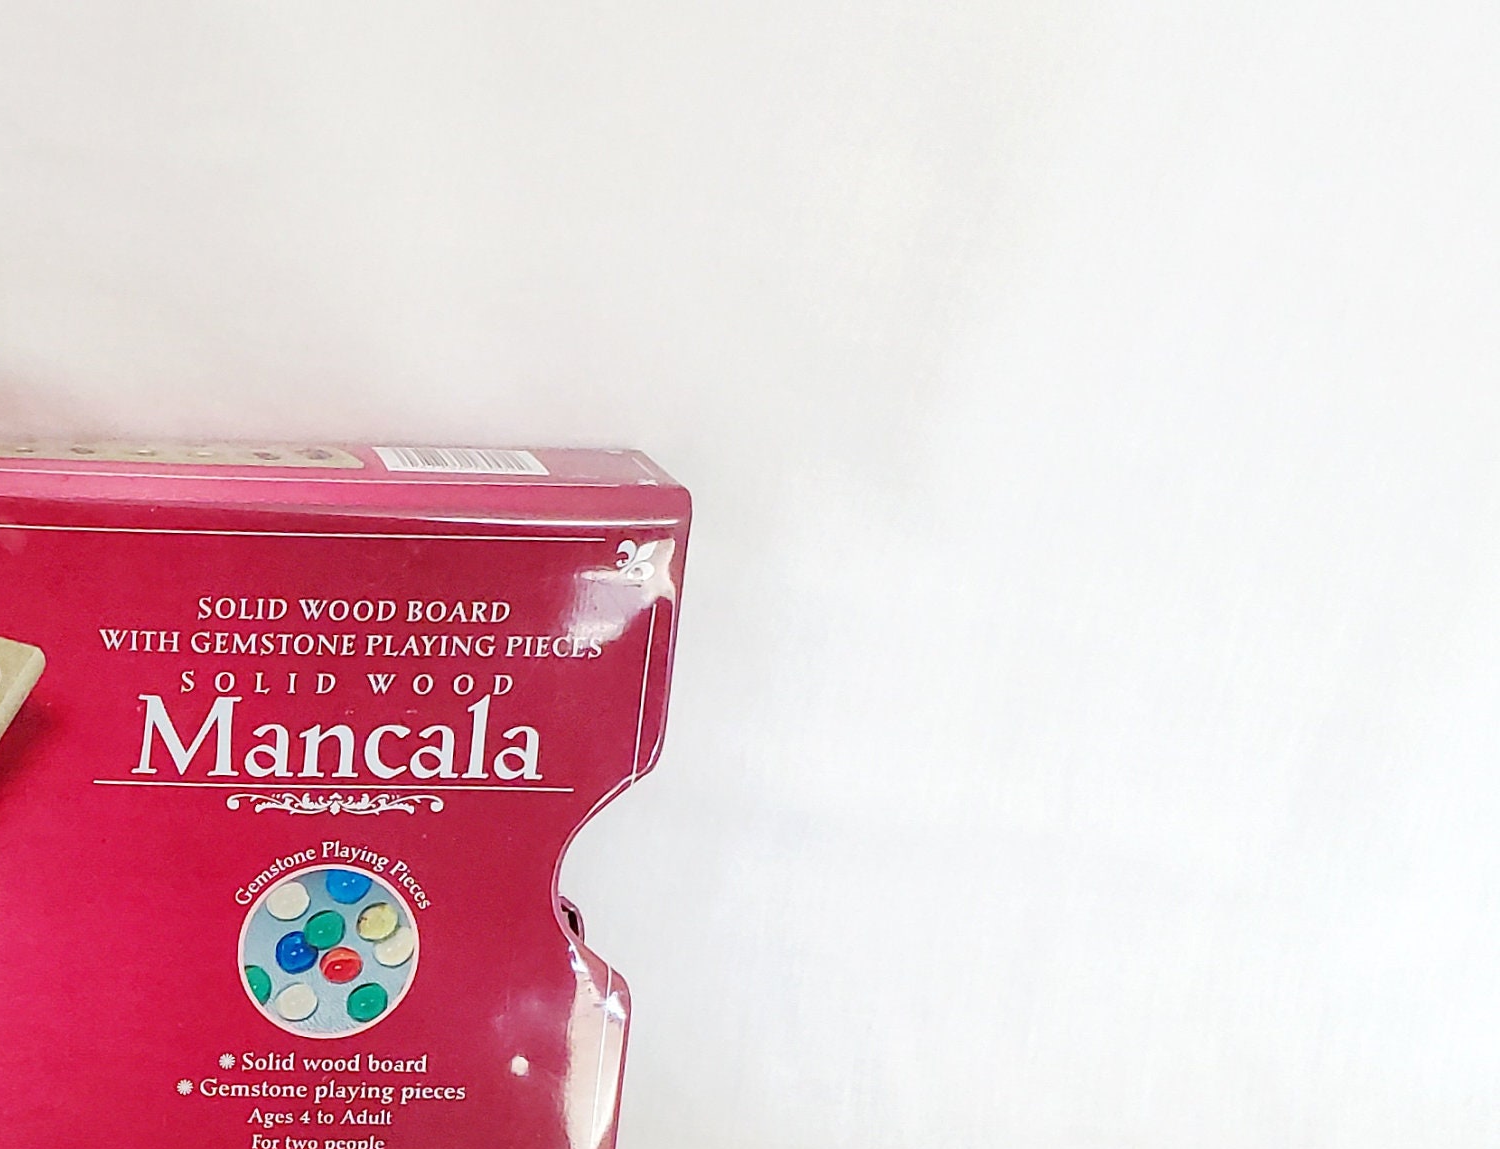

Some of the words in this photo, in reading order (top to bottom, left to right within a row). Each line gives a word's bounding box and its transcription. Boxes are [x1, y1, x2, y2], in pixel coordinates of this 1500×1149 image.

[197, 597, 288, 621] SOLID
[299, 598, 397, 622] WOOD
[406, 599, 511, 623] BOARD
[99, 628, 179, 652] WITH
[190, 631, 357, 656] GEMSTONE
[364, 633, 496, 658] PLAYING
[505, 635, 603, 659] PIECES
[180, 671, 337, 695] SOLID
[367, 673, 514, 696] WOOD
[131, 694, 544, 781] Mancala
[235, 848, 317, 905] Gemstone
[322, 840, 390, 871] Playing
[389, 860, 431, 910] Pieces
[241, 1052, 295, 1072] Solid
[303, 1053, 361, 1073] wood
[368, 1053, 428, 1074] board
[199, 1078, 308, 1098] Gemstone
[314, 1080, 395, 1104] playing
[400, 1083, 467, 1105] pieces
[247, 1108, 294, 1128] Ages
[299, 1110, 311, 1125] 4
[316, 1110, 335, 1125] to
[339, 1109, 393, 1126] Adult
